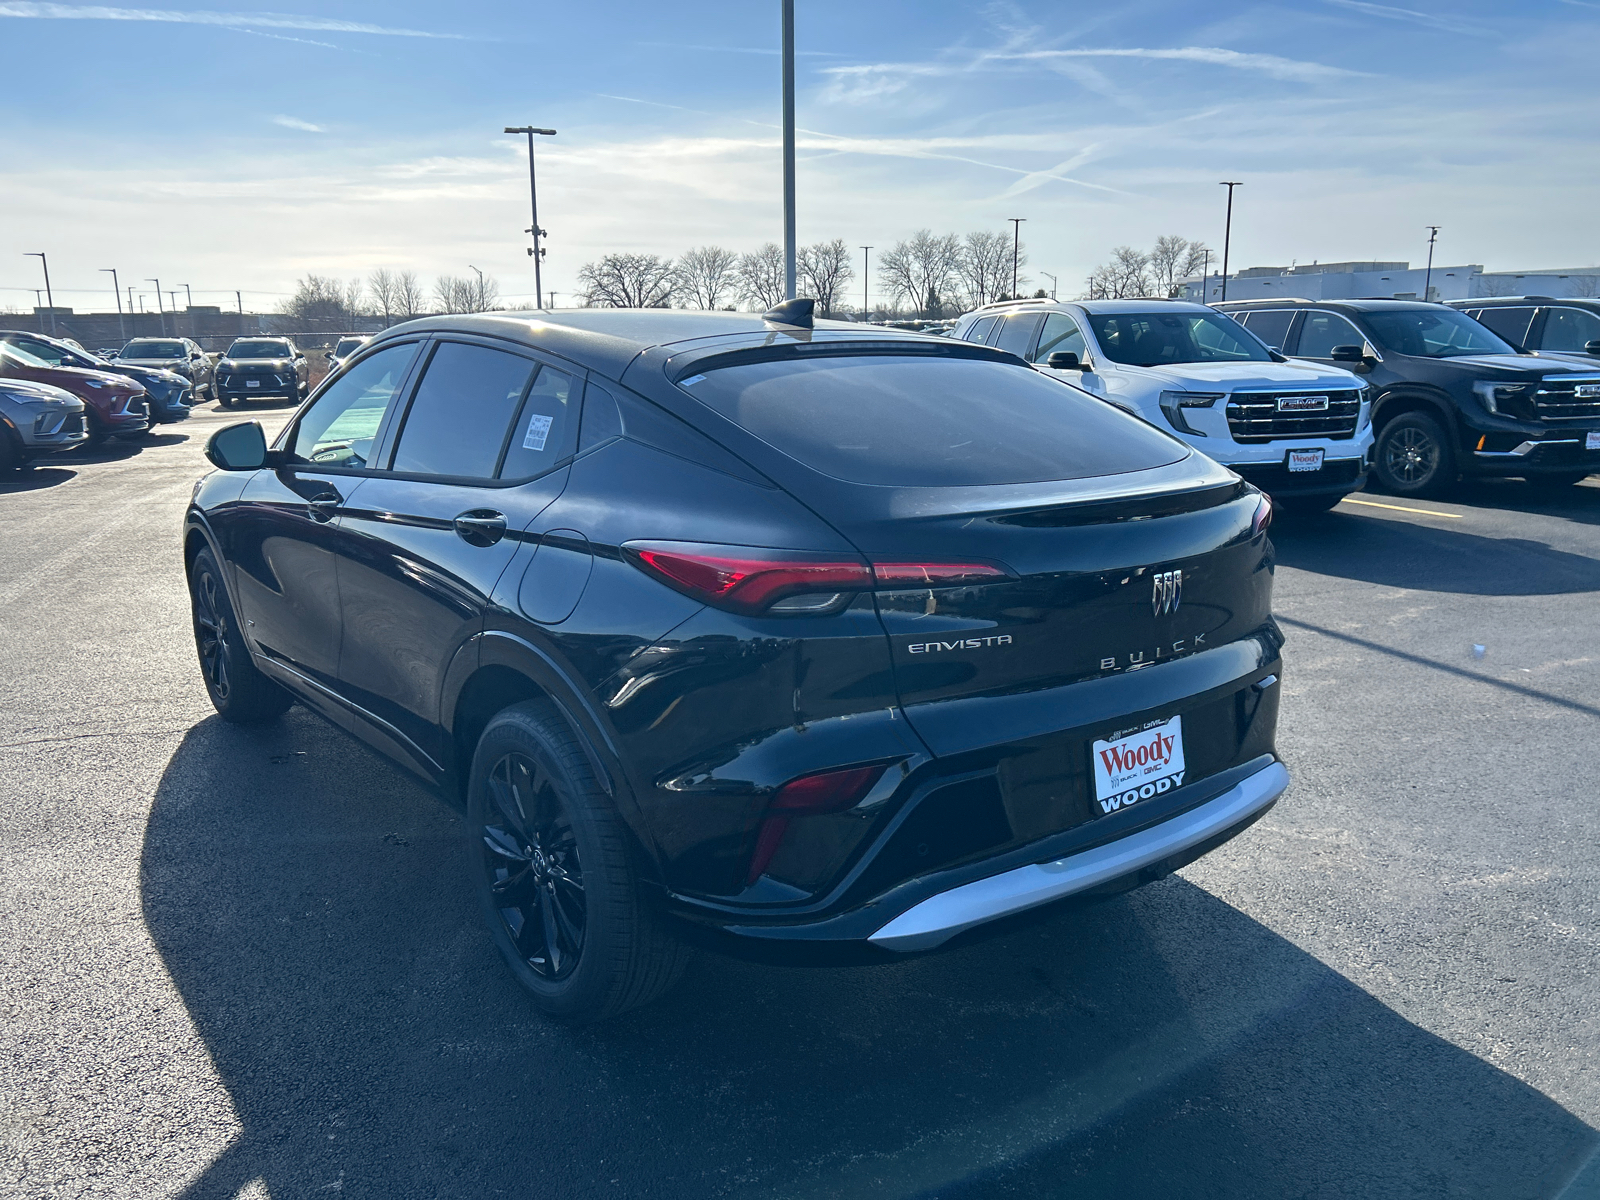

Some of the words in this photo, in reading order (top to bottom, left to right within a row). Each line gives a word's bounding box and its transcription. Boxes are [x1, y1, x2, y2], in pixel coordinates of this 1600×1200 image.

[1281, 398, 1327, 409] GMC
[1292, 454, 1319, 463] Woody
[908, 634, 1013, 654] ENVISTA
[1100, 633, 1206, 670] BUICK
[1099, 732, 1176, 777] Woody
[1143, 763, 1162, 775] GMC
[1100, 771, 1185, 814] WOODY
